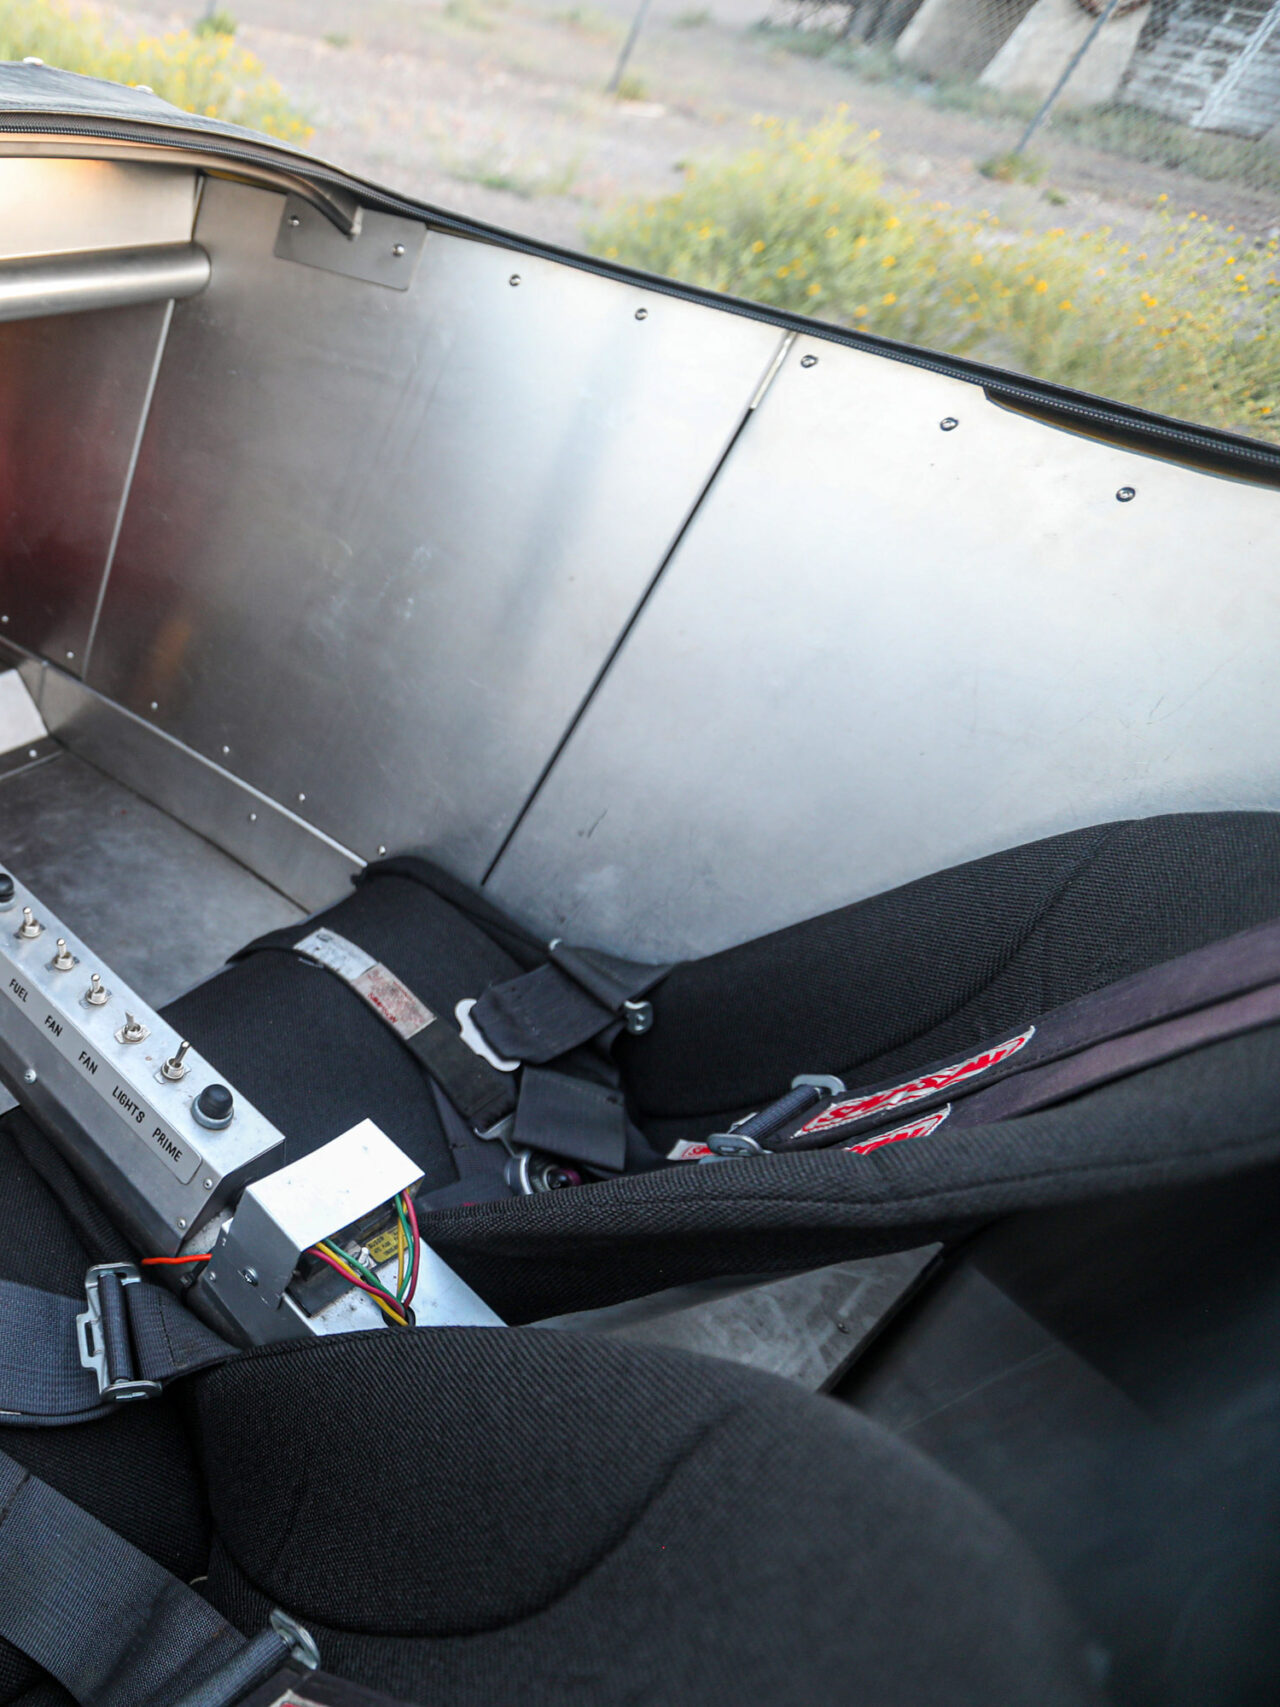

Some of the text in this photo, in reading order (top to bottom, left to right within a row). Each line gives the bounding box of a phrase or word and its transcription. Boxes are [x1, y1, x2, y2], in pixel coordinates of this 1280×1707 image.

[9, 978, 29, 1003] FUEL
[44, 1015, 63, 1037] FAN
[78, 1051, 99, 1075] FAN
[112, 1086, 146, 1124] LIGHTS
[152, 1127, 183, 1162] PRIME
